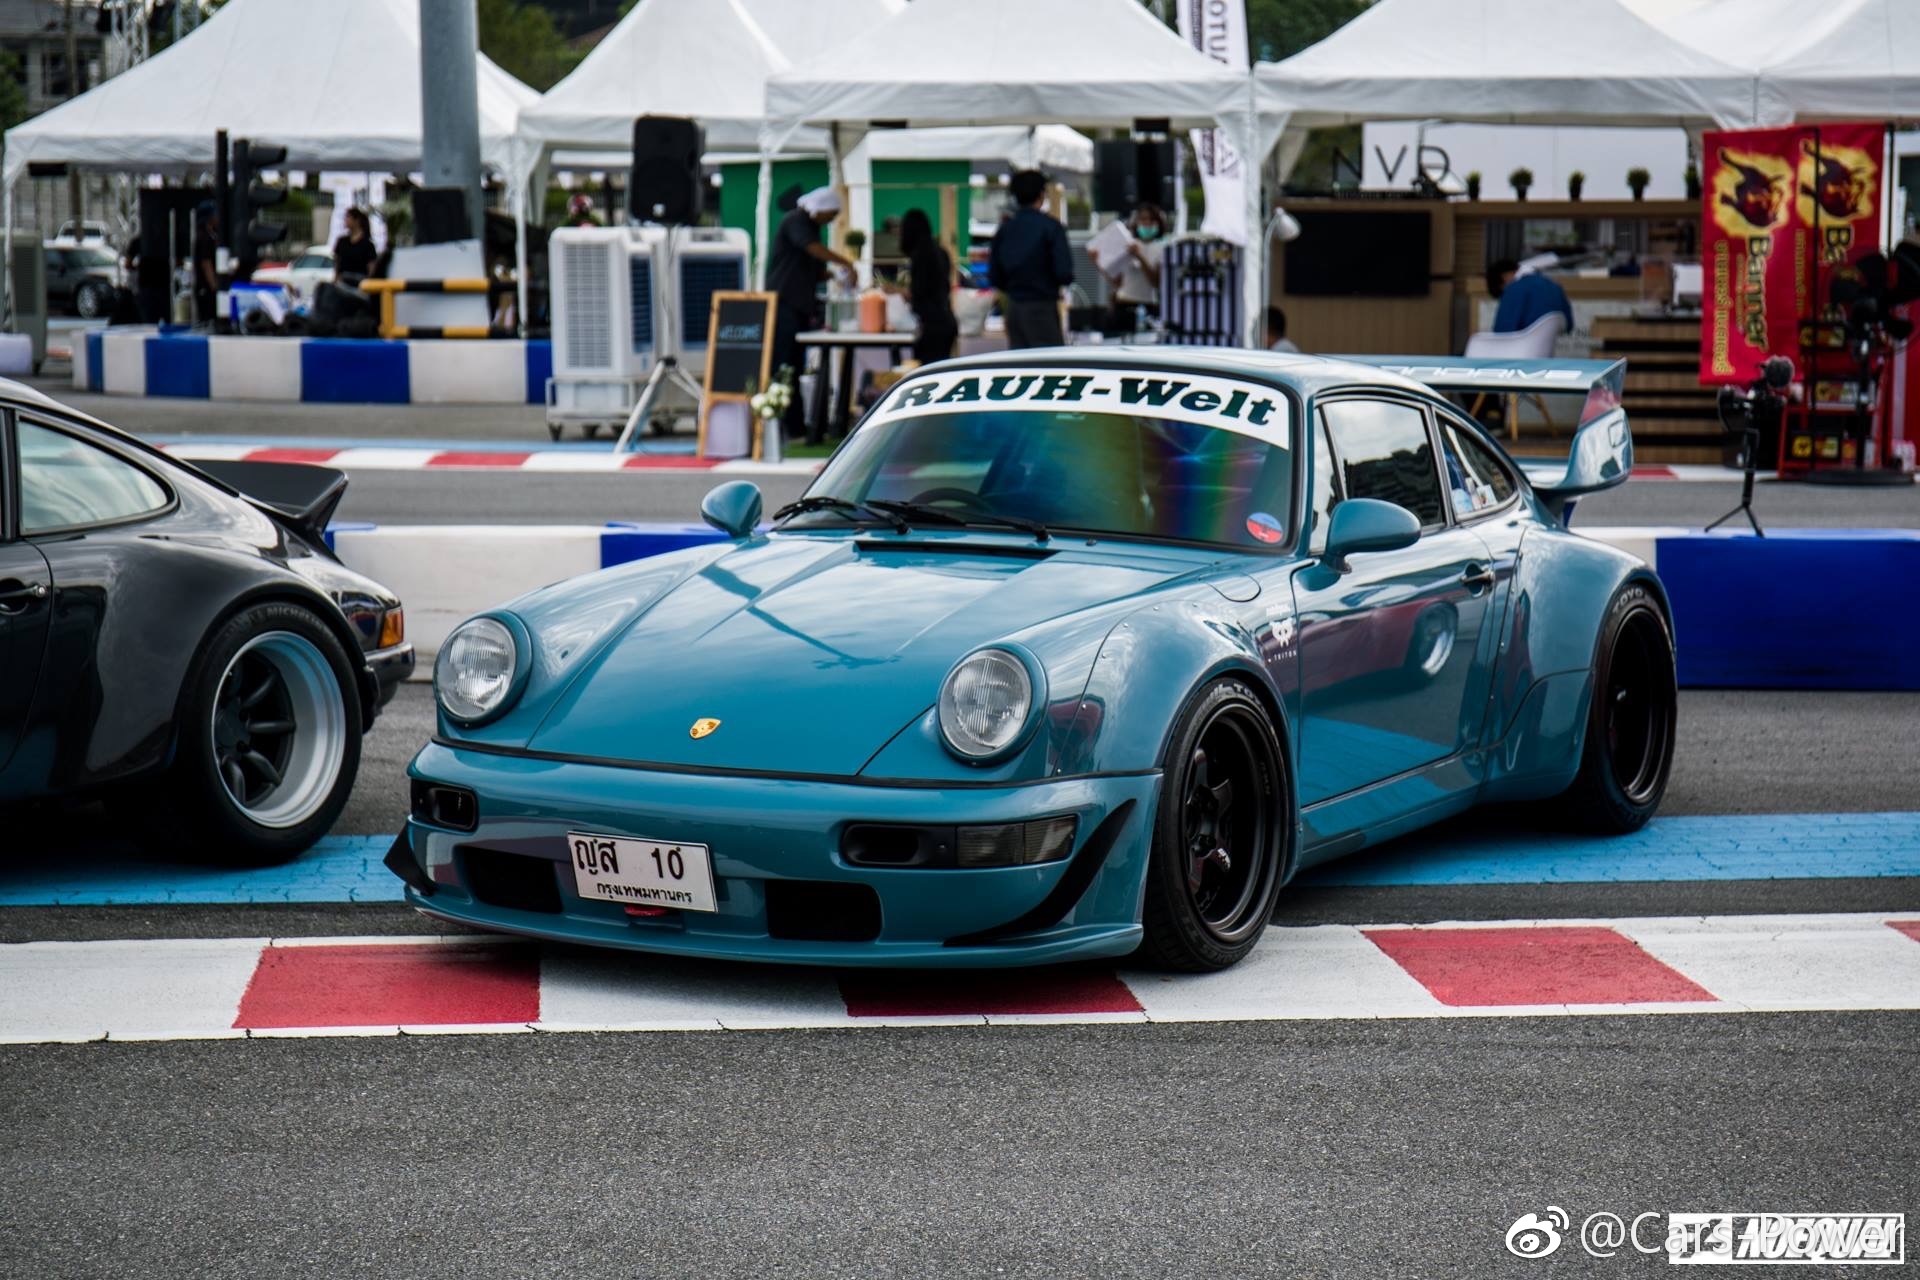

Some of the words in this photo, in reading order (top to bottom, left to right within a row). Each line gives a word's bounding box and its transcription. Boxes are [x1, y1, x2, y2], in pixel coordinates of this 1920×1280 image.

[1748, 236, 1771, 350] Banner
[887, 375, 1276, 426] RAUH-Welt
[651, 847, 684, 880] 10
[596, 882, 693, 904] กรุงเทพมหานคร
